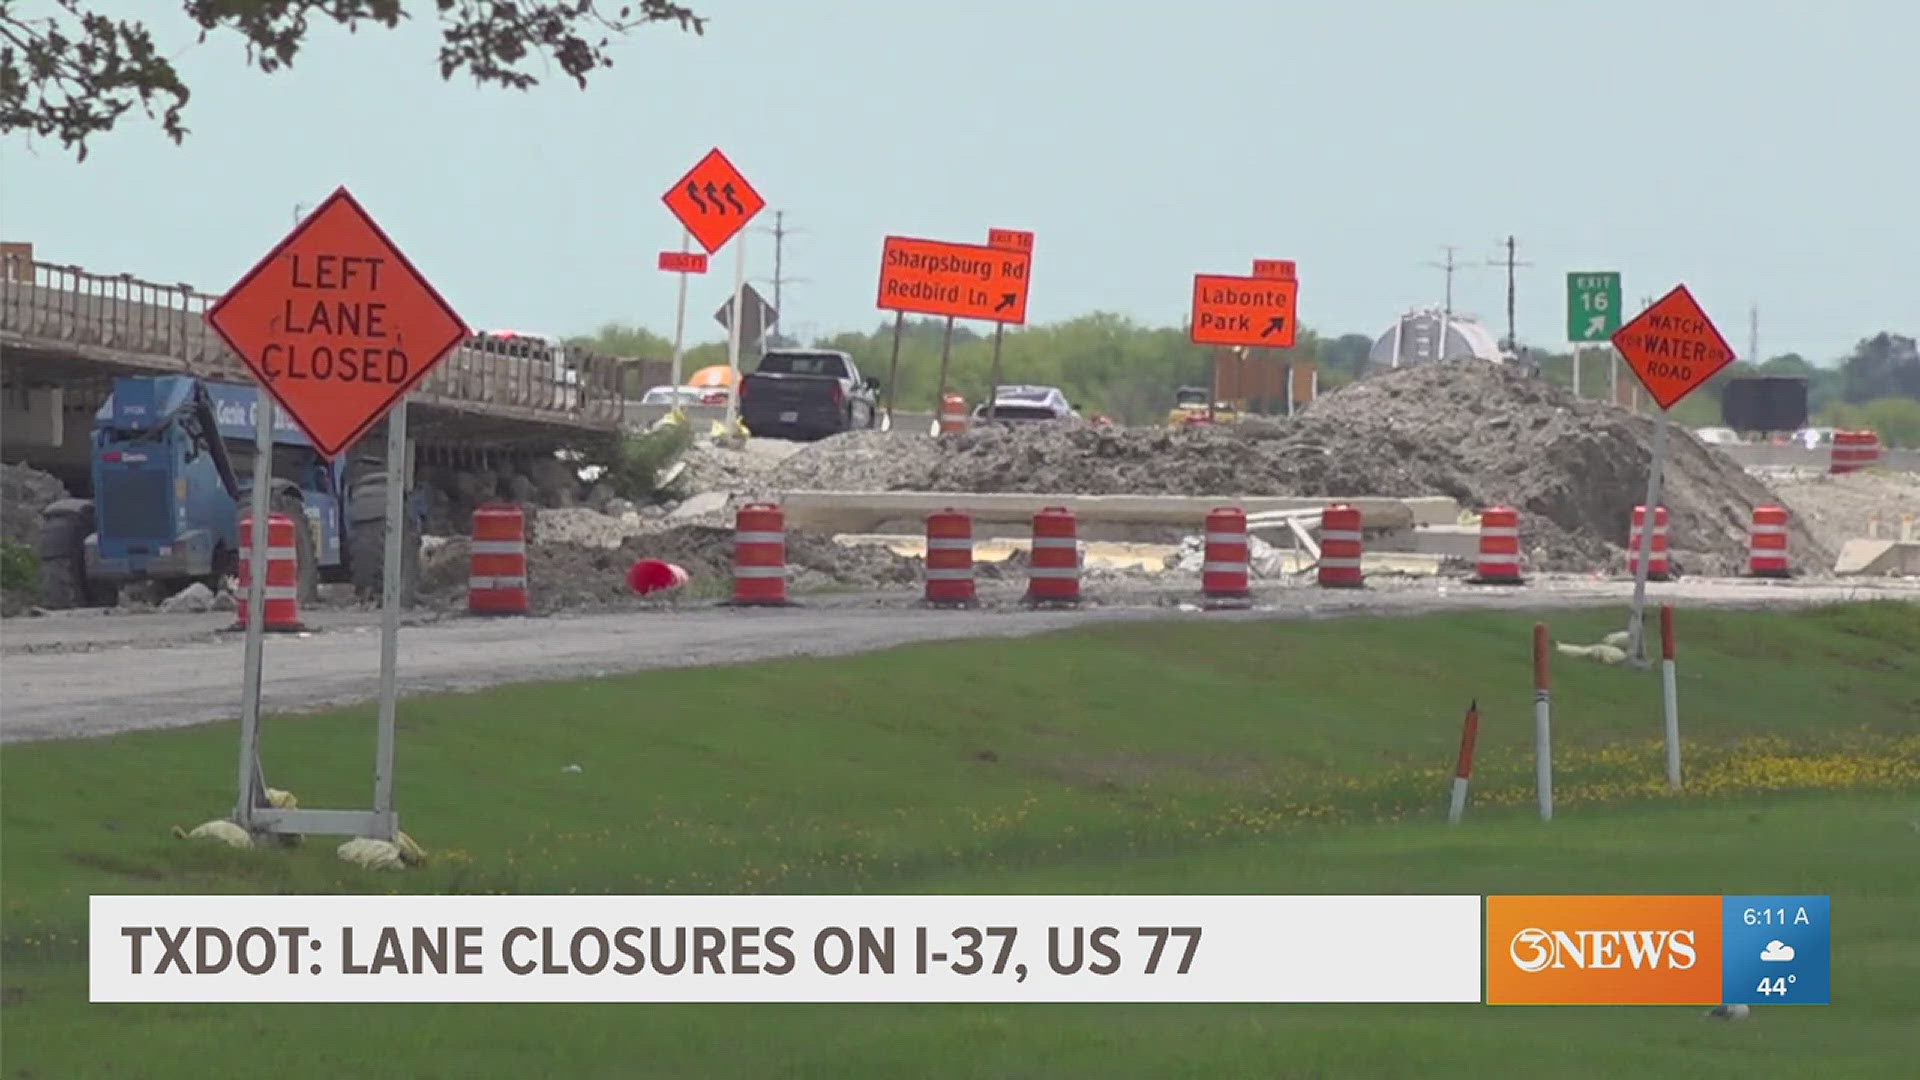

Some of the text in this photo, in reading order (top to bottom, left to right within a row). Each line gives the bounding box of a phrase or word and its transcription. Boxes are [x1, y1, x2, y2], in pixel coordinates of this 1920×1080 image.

[291, 255, 384, 291] LEFT
[887, 249, 1024, 281] Sharpsburg Rd
[887, 279, 987, 306] Redbird Ln
[1576, 276, 1611, 290] EXIT
[1203, 287, 1286, 308] Labonte
[1581, 292, 1608, 311] 16
[285, 299, 387, 338] LANE
[1200, 311, 1250, 331] Park
[1649, 315, 1704, 335] WATCH
[1644, 334, 1706, 362] WATER
[261, 344, 408, 384] CLOSED
[1647, 361, 1692, 381] ROAD
